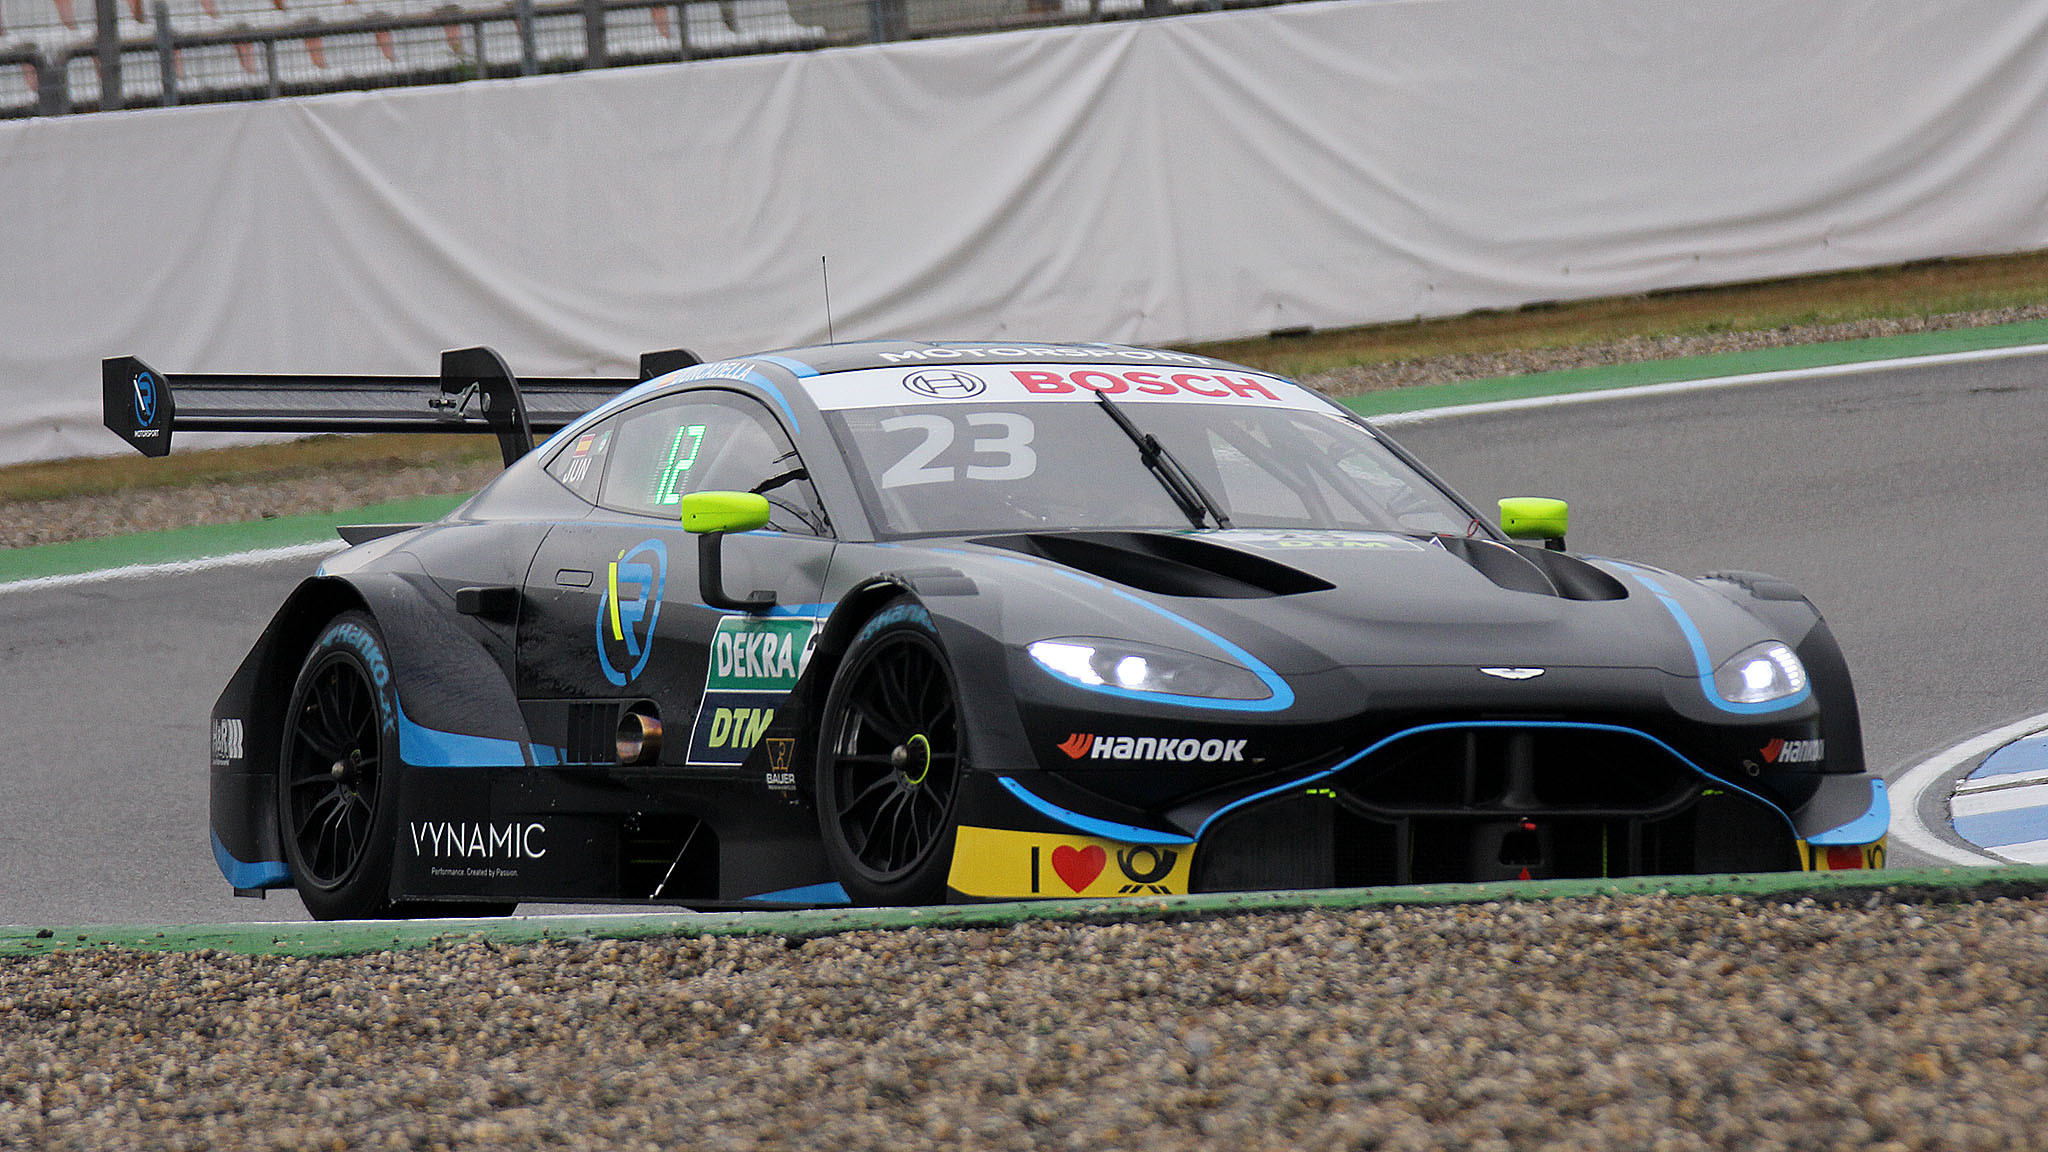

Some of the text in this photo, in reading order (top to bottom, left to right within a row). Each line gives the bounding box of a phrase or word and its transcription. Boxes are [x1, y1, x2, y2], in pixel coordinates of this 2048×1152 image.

[880, 348, 1212, 365] MOTORSPORT
[1010, 370, 1282, 401] BOSCH
[654, 424, 707, 505] 12
[879, 412, 1037, 489] 23
[562, 457, 592, 484] JUN
[716, 631, 796, 678] DEKRA
[766, 773, 796, 784] BAUER
[410, 821, 547, 858] VYNAMIC
[466, 867, 488, 876] Created
[488, 867, 495, 878] by
[1031, 846, 1040, 893] I
